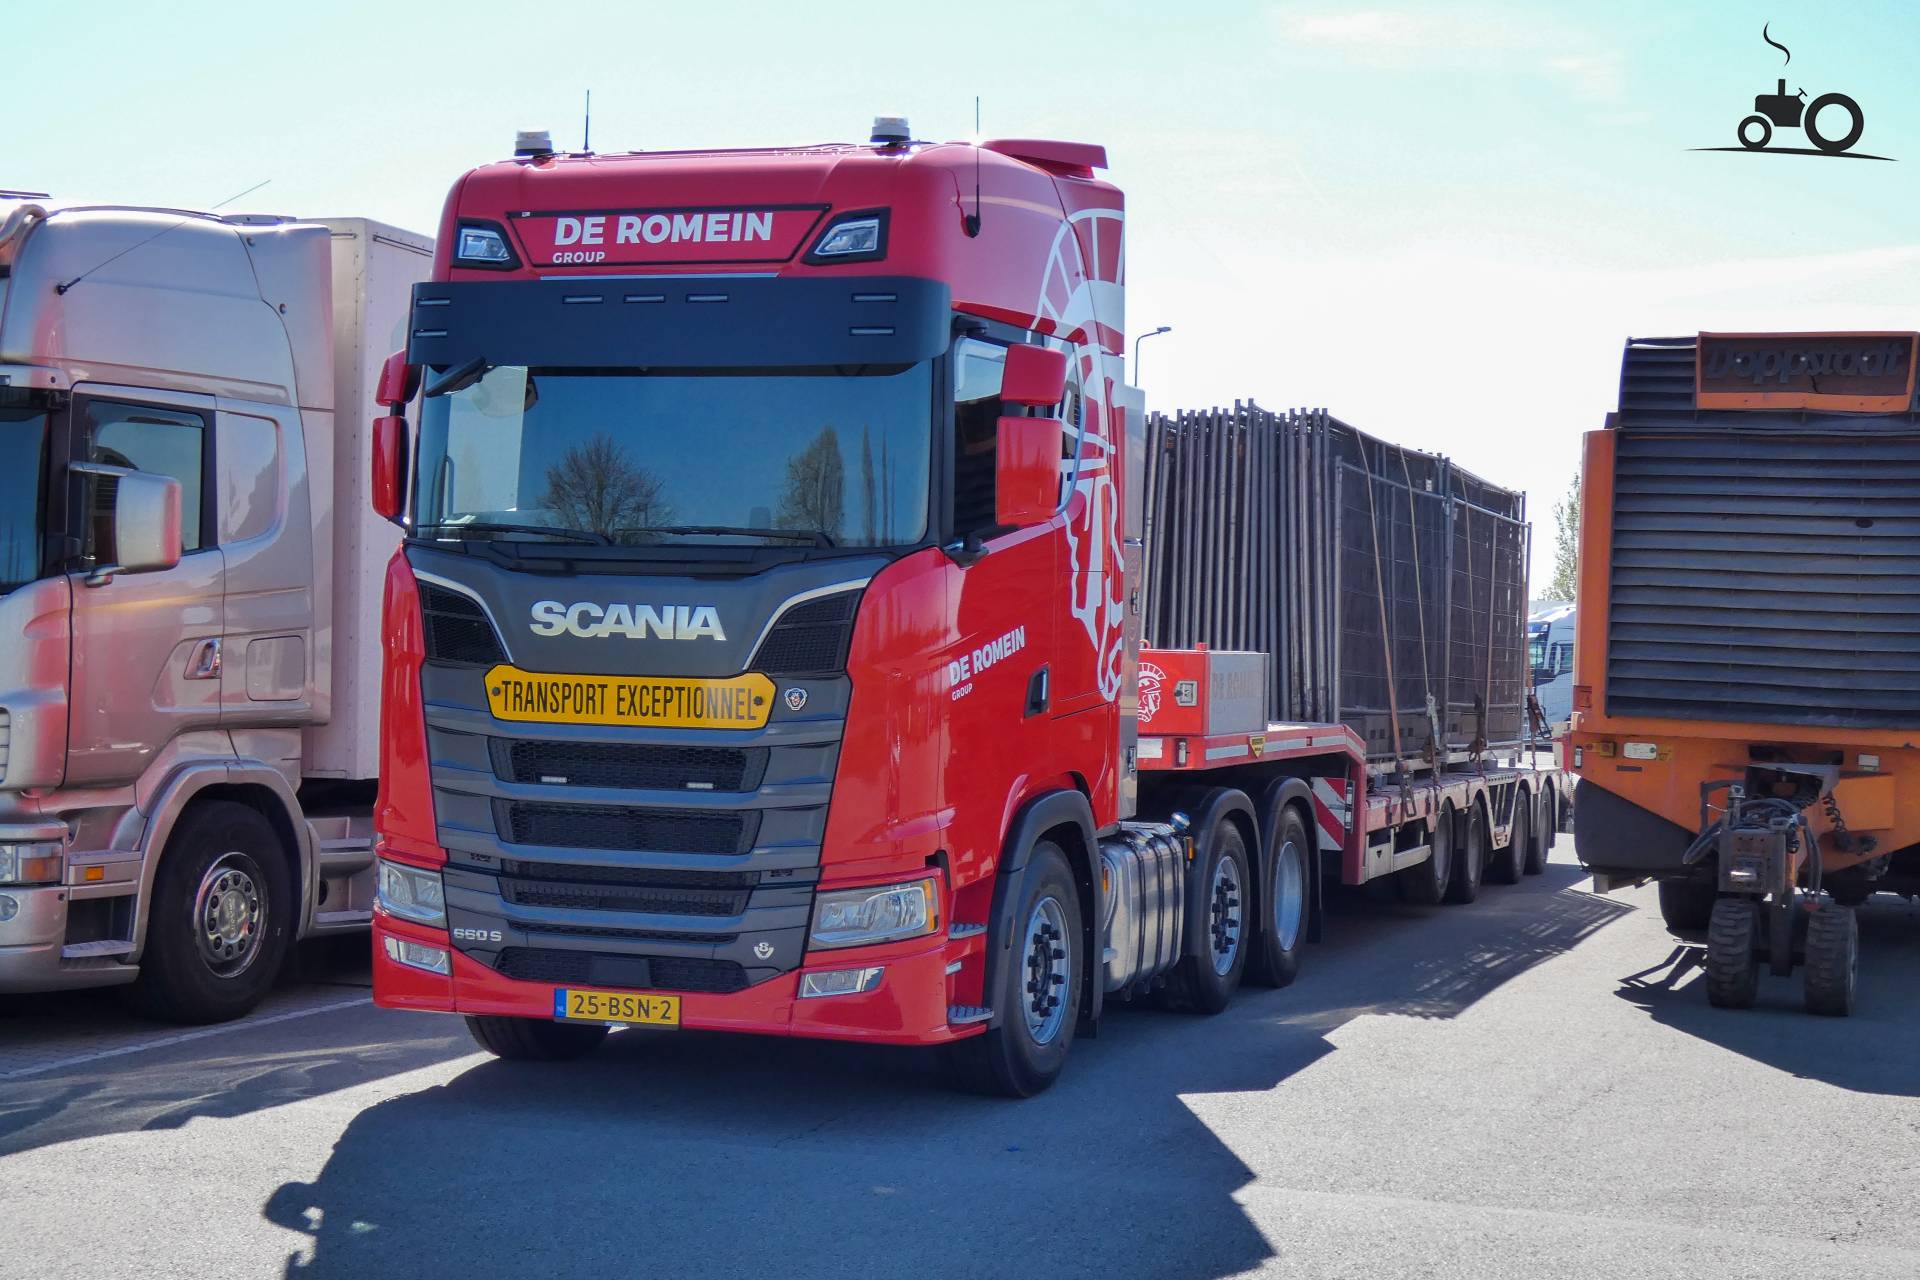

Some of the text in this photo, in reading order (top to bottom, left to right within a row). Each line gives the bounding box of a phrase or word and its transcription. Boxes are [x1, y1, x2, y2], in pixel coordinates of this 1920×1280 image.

[554, 212, 773, 246] DE ROMEIN
[552, 251, 606, 264] GROUP
[529, 600, 727, 641] SCANIA
[949, 625, 1025, 687] DE ROMEIN
[501, 680, 757, 721] TRANSPORT EXCEPTIONNEL
[952, 683, 972, 701] GROUP
[453, 928, 502, 942] 660 S
[573, 995, 672, 1020] 25-BSN-2
